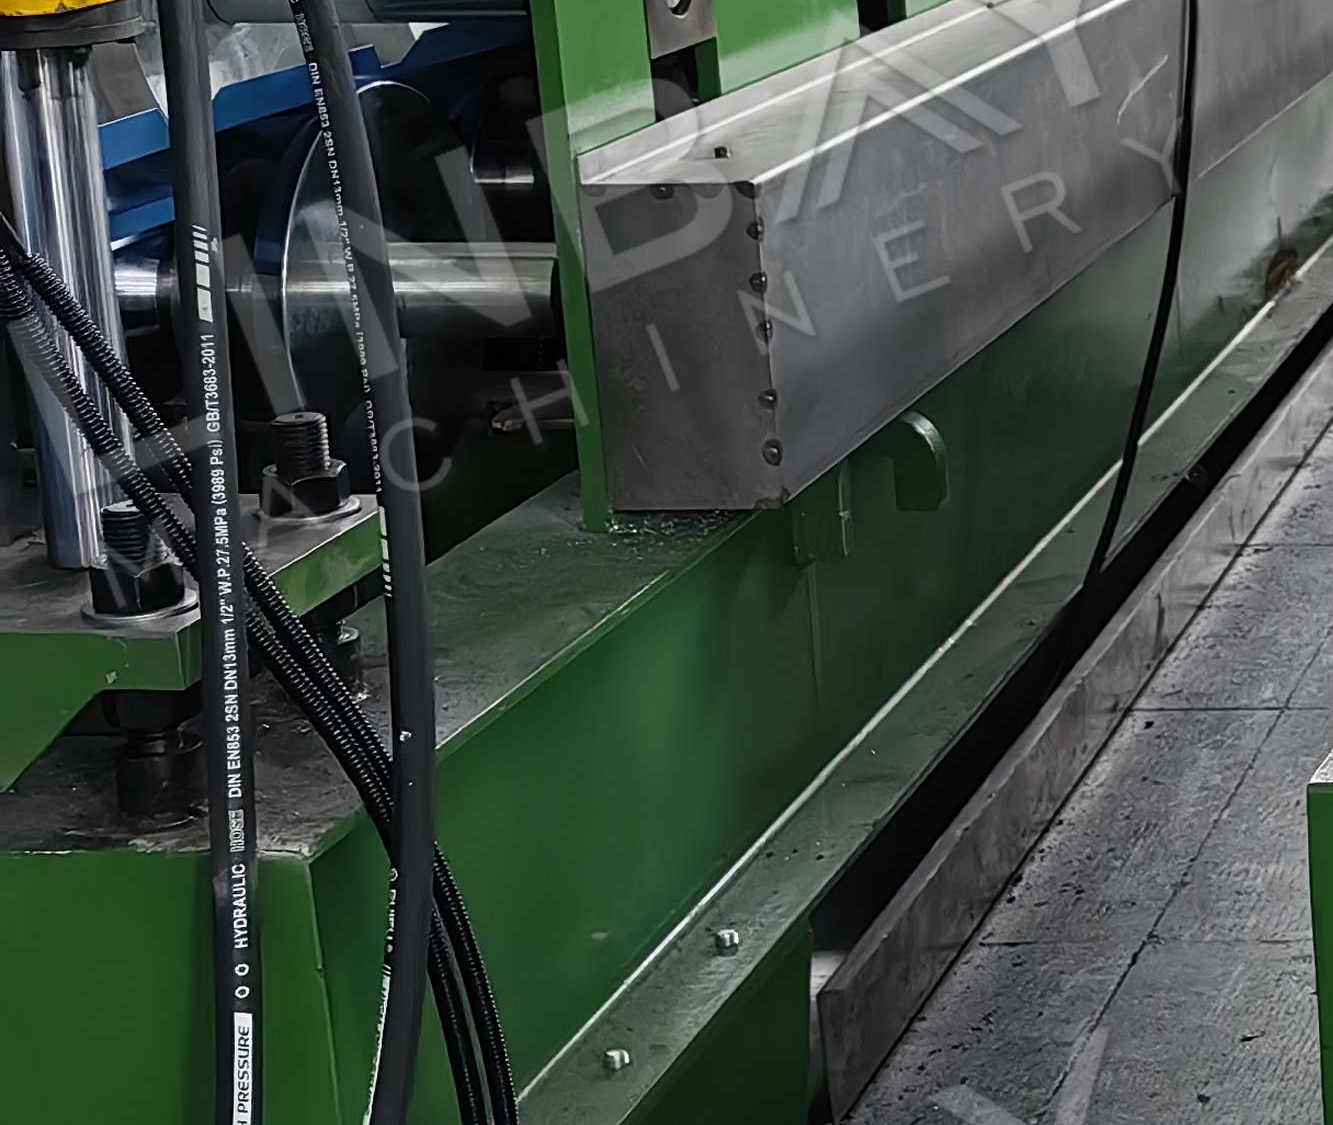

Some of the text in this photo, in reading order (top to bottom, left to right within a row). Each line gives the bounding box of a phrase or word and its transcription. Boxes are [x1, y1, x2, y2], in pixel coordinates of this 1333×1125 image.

[308, 62, 321, 85] DIN
[200, 333, 221, 433] GB/T3683-2011
[207, 440, 225, 465] Psi)
[211, 469, 228, 506] (3989
[212, 507, 233, 594] W.P.27.5MPa
[219, 598, 234, 625] 1/2"
[221, 628, 237, 692] DN13mm
[224, 694, 239, 722] 2SN
[226, 725, 241, 771] EN853
[228, 773, 242, 799] DIN
[231, 863, 248, 949] HYDRAULIC
[236, 1024, 251, 1114] PRESSURE
